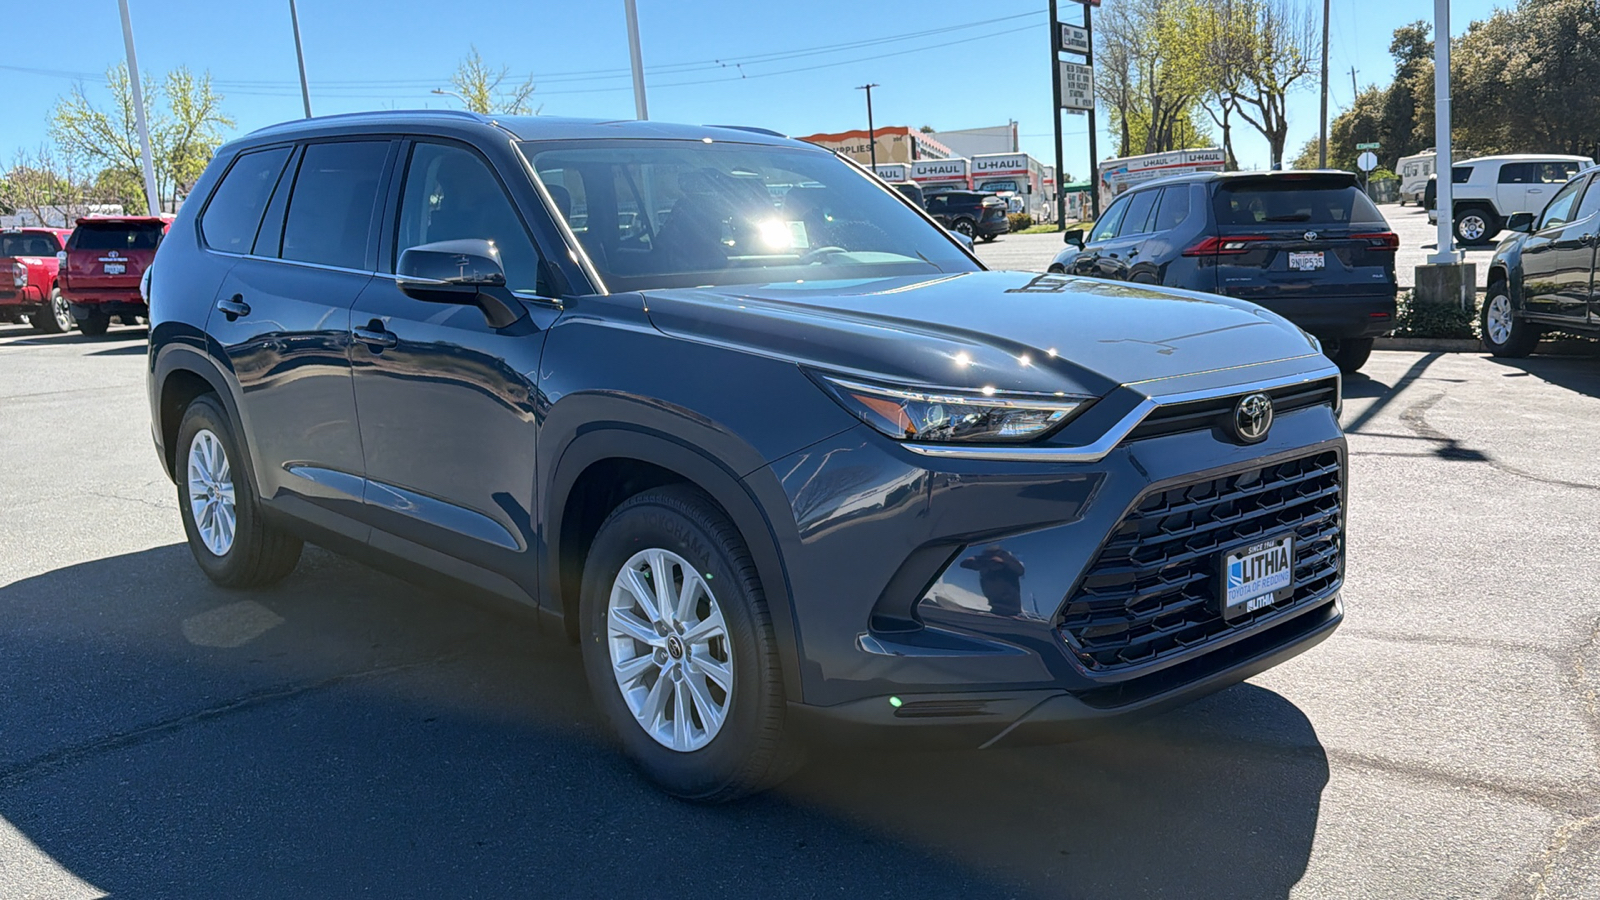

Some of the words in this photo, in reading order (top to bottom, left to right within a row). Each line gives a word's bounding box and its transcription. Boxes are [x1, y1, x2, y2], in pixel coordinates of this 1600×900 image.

[1189, 153, 1220, 161] U-HAUL
[917, 165, 960, 174] U-HAUL
[977, 160, 1022, 170] U-HAUL
[879, 170, 900, 178] AUL
[643, 512, 711, 567] YOKOHAMA
[1248, 543, 1263, 554] SINCE
[1242, 547, 1288, 584] LITHIA
[1228, 584, 1252, 600] TOYOTA
[1252, 580, 1261, 591] OF
[1262, 570, 1289, 588] REDDING
[1253, 592, 1275, 610] LITHIA
